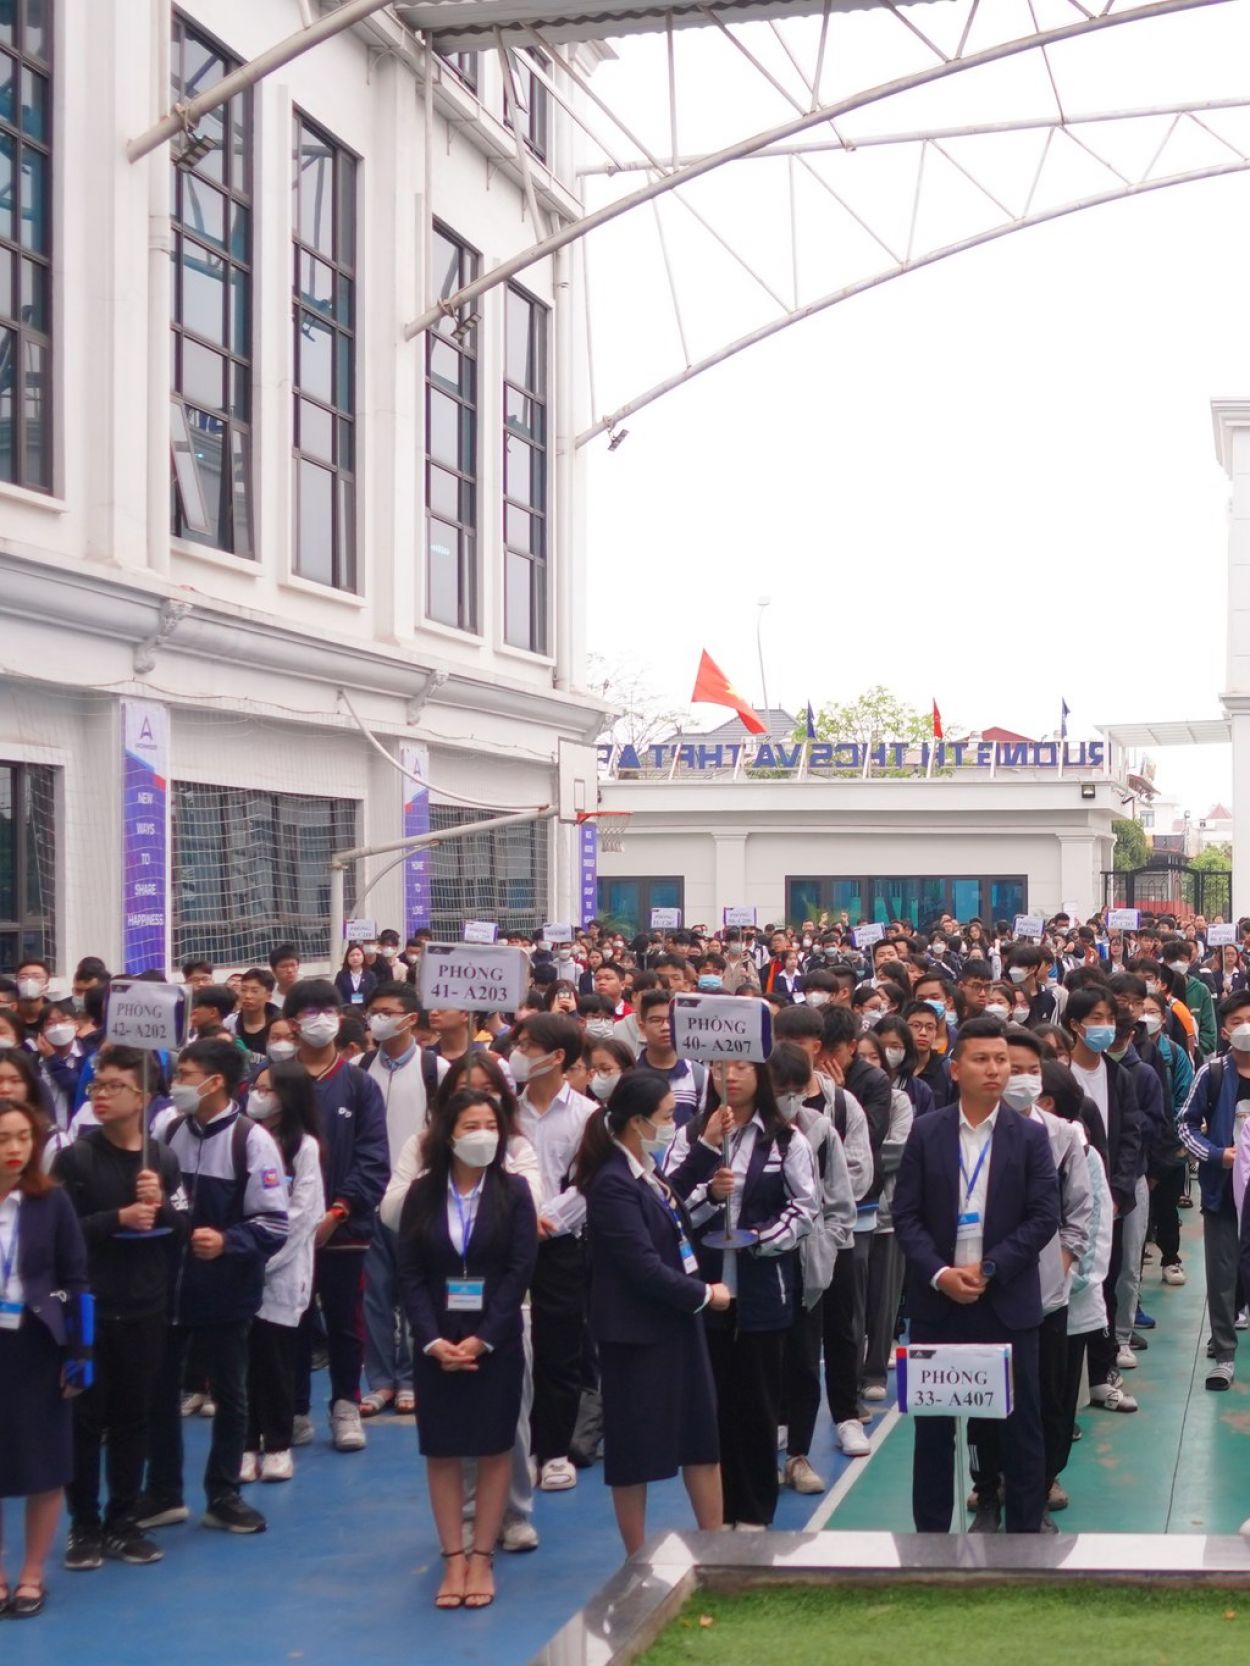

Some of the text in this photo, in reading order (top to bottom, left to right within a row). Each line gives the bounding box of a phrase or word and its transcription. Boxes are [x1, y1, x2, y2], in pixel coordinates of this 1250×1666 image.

[431, 983, 507, 1001] 41- A203
[682, 1036, 751, 1053] 40- A207
[914, 1390, 994, 1407] 33- A407
